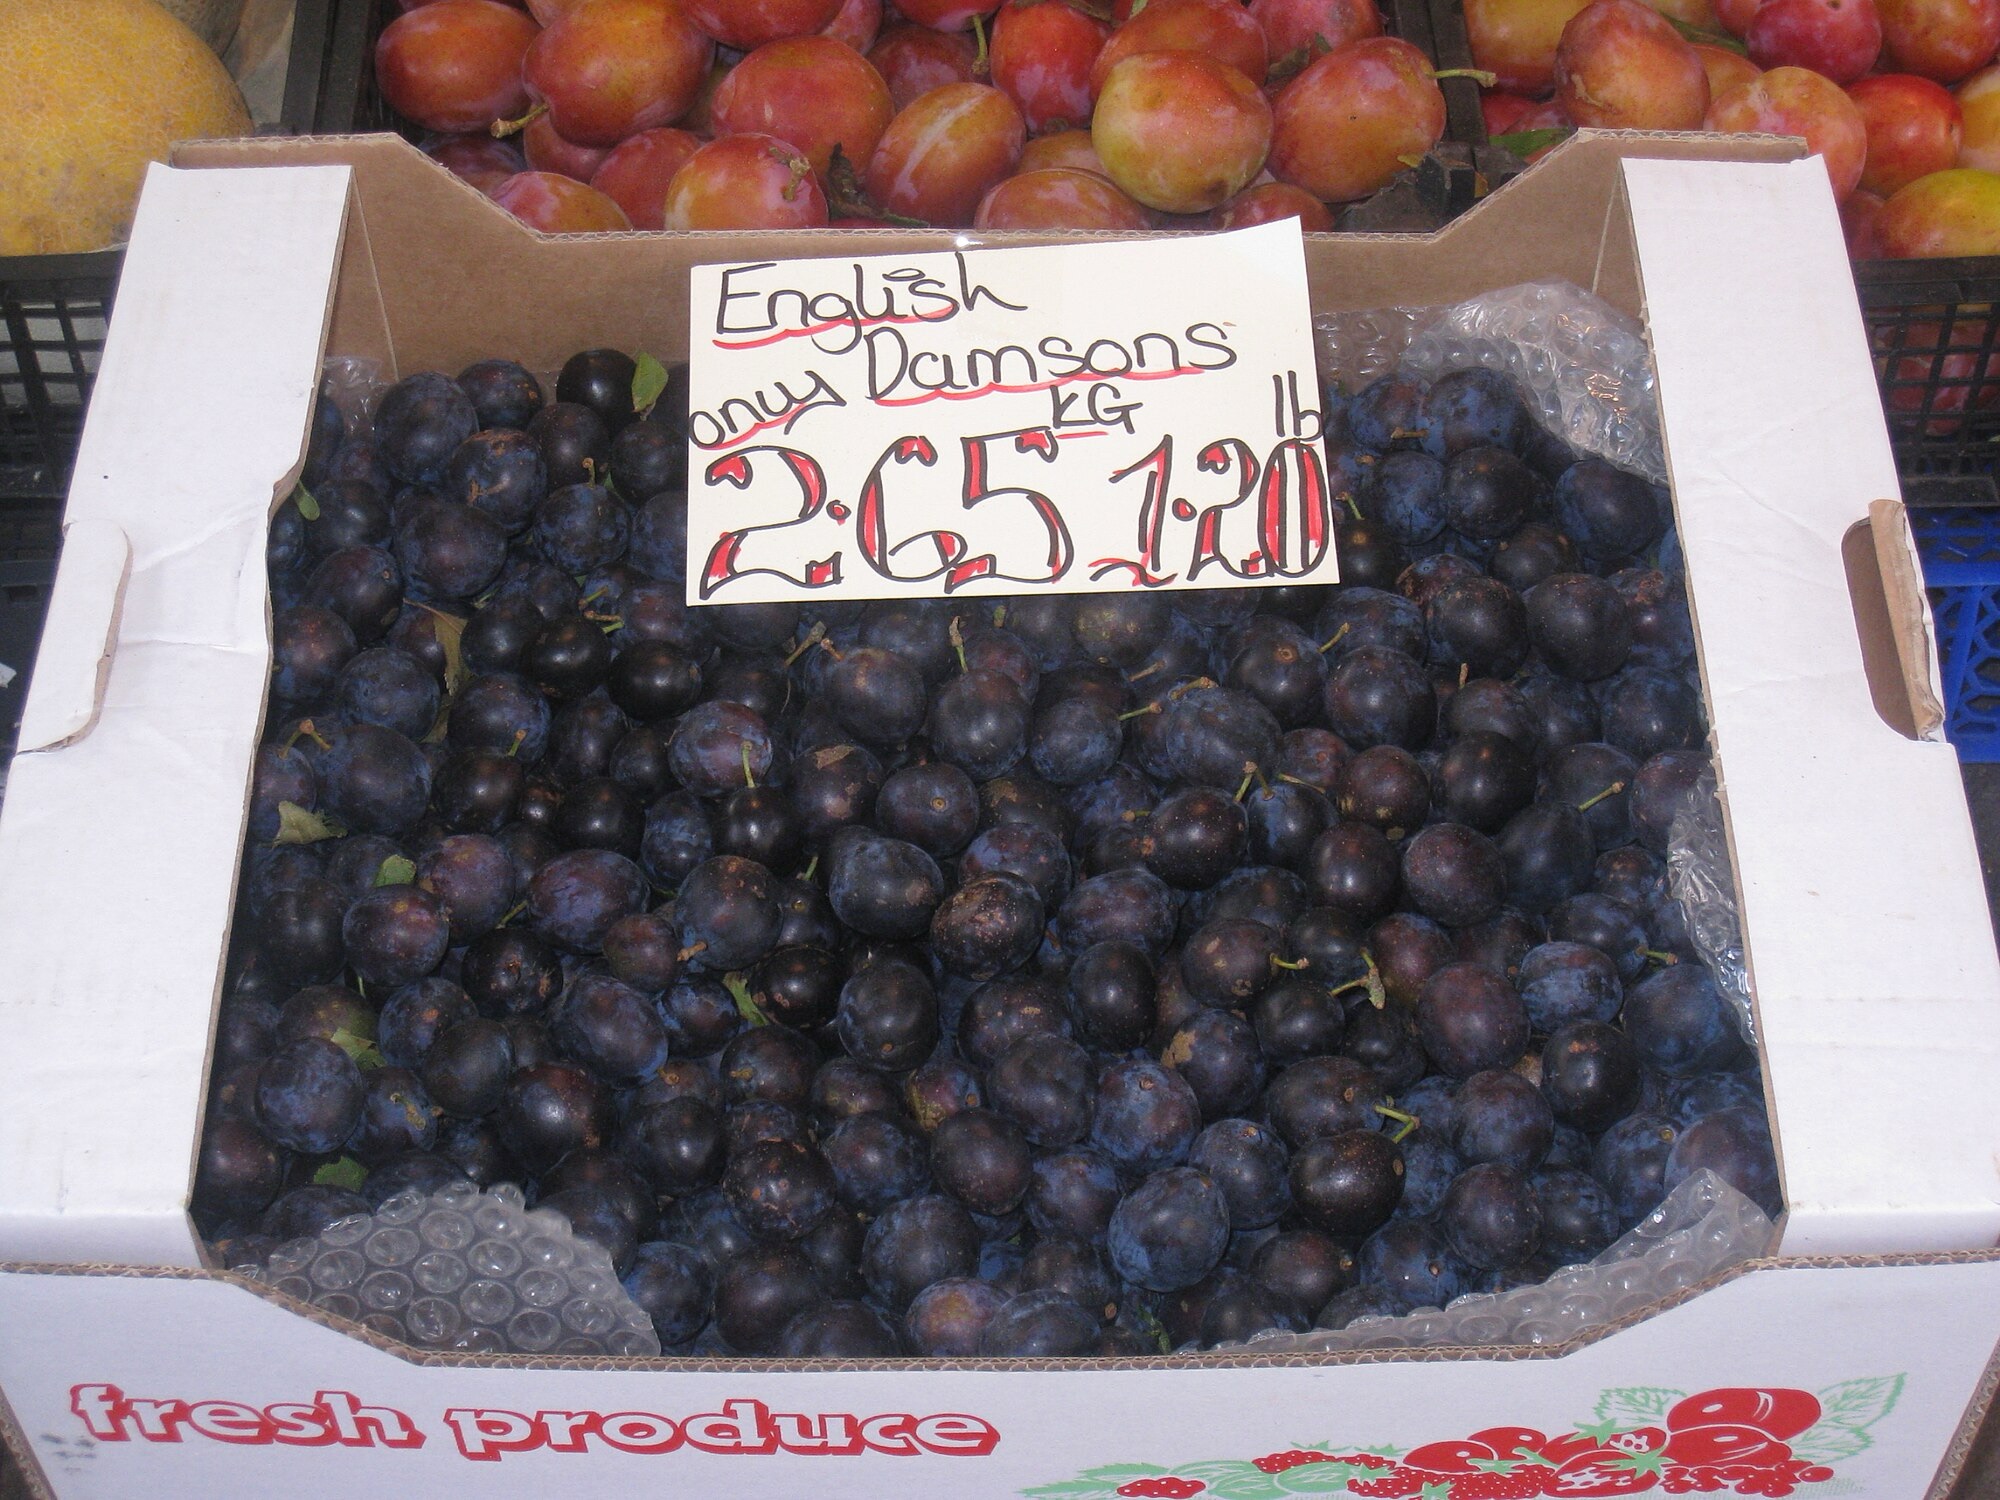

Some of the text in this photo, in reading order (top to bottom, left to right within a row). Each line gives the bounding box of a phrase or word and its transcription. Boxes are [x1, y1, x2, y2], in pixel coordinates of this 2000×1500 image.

[717, 252, 1027, 354] English
[864, 322, 1237, 400] Damsons
[1274, 371, 1322, 441] lb
[70, 1383, 1001, 1461] fresh produce
